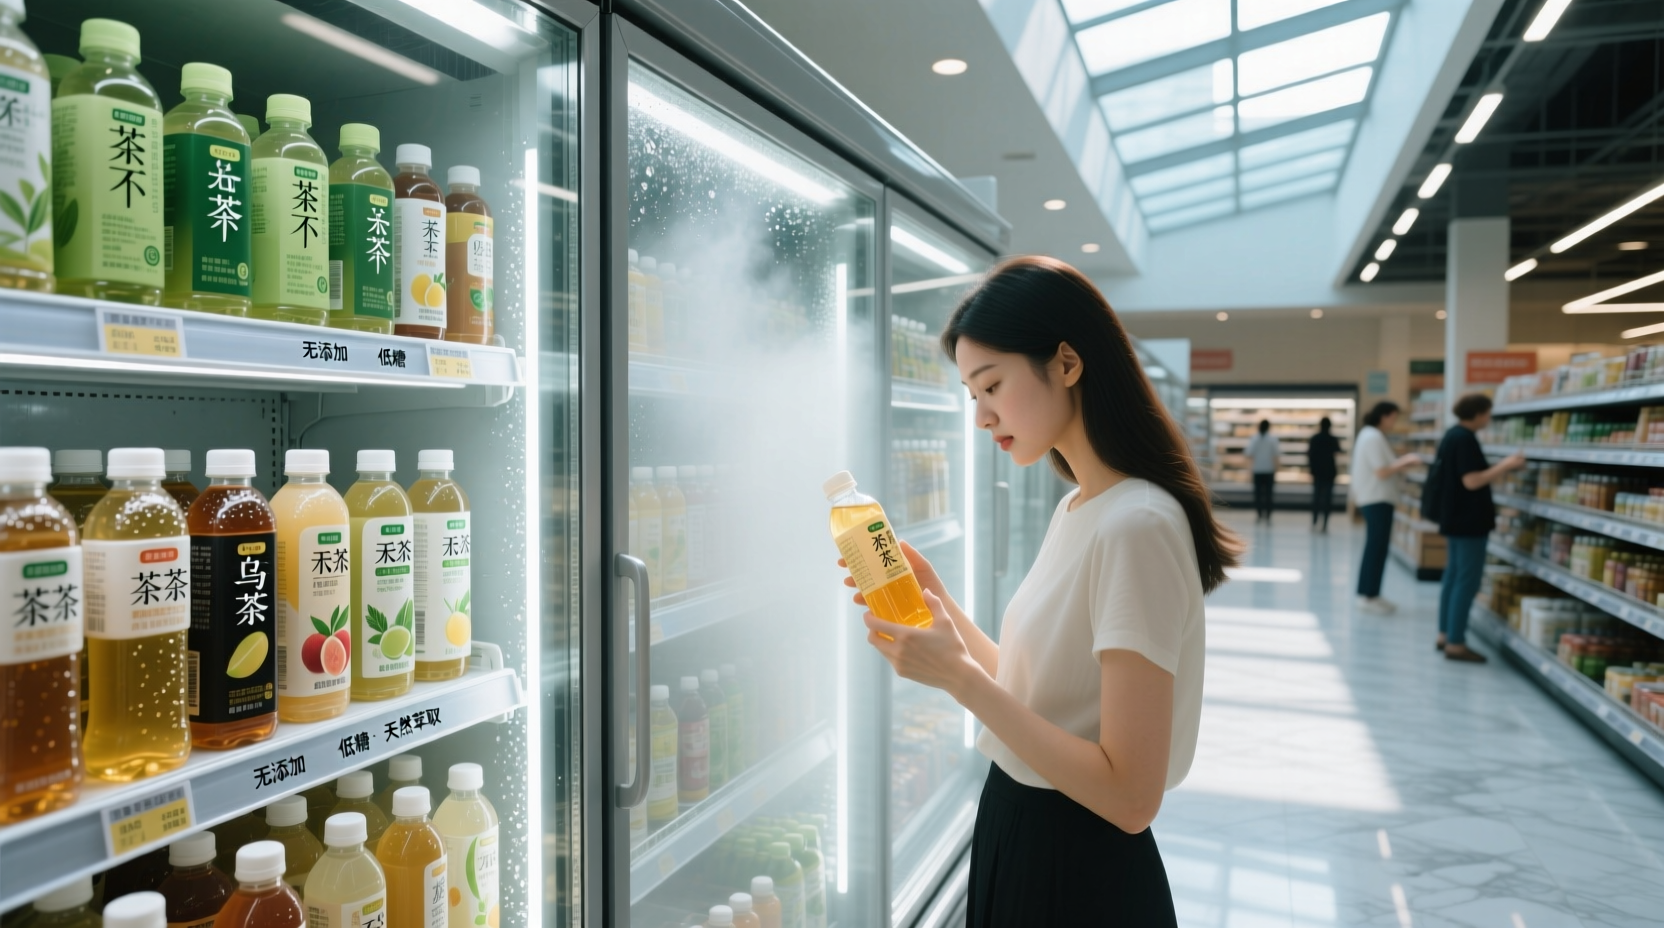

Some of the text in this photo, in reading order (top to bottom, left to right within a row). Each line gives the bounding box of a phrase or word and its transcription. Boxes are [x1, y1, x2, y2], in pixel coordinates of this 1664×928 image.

[109, 125, 145, 208] 茶不
[291, 180, 318, 248] 茶不
[303, 341, 348, 361] 无添加
[378, 348, 406, 368] 低糖
[13, 584, 79, 627] 茶茶
[131, 568, 188, 605] 茶茶
[234, 556, 268, 626] 乌茶
[253, 755, 306, 789] 无添加
